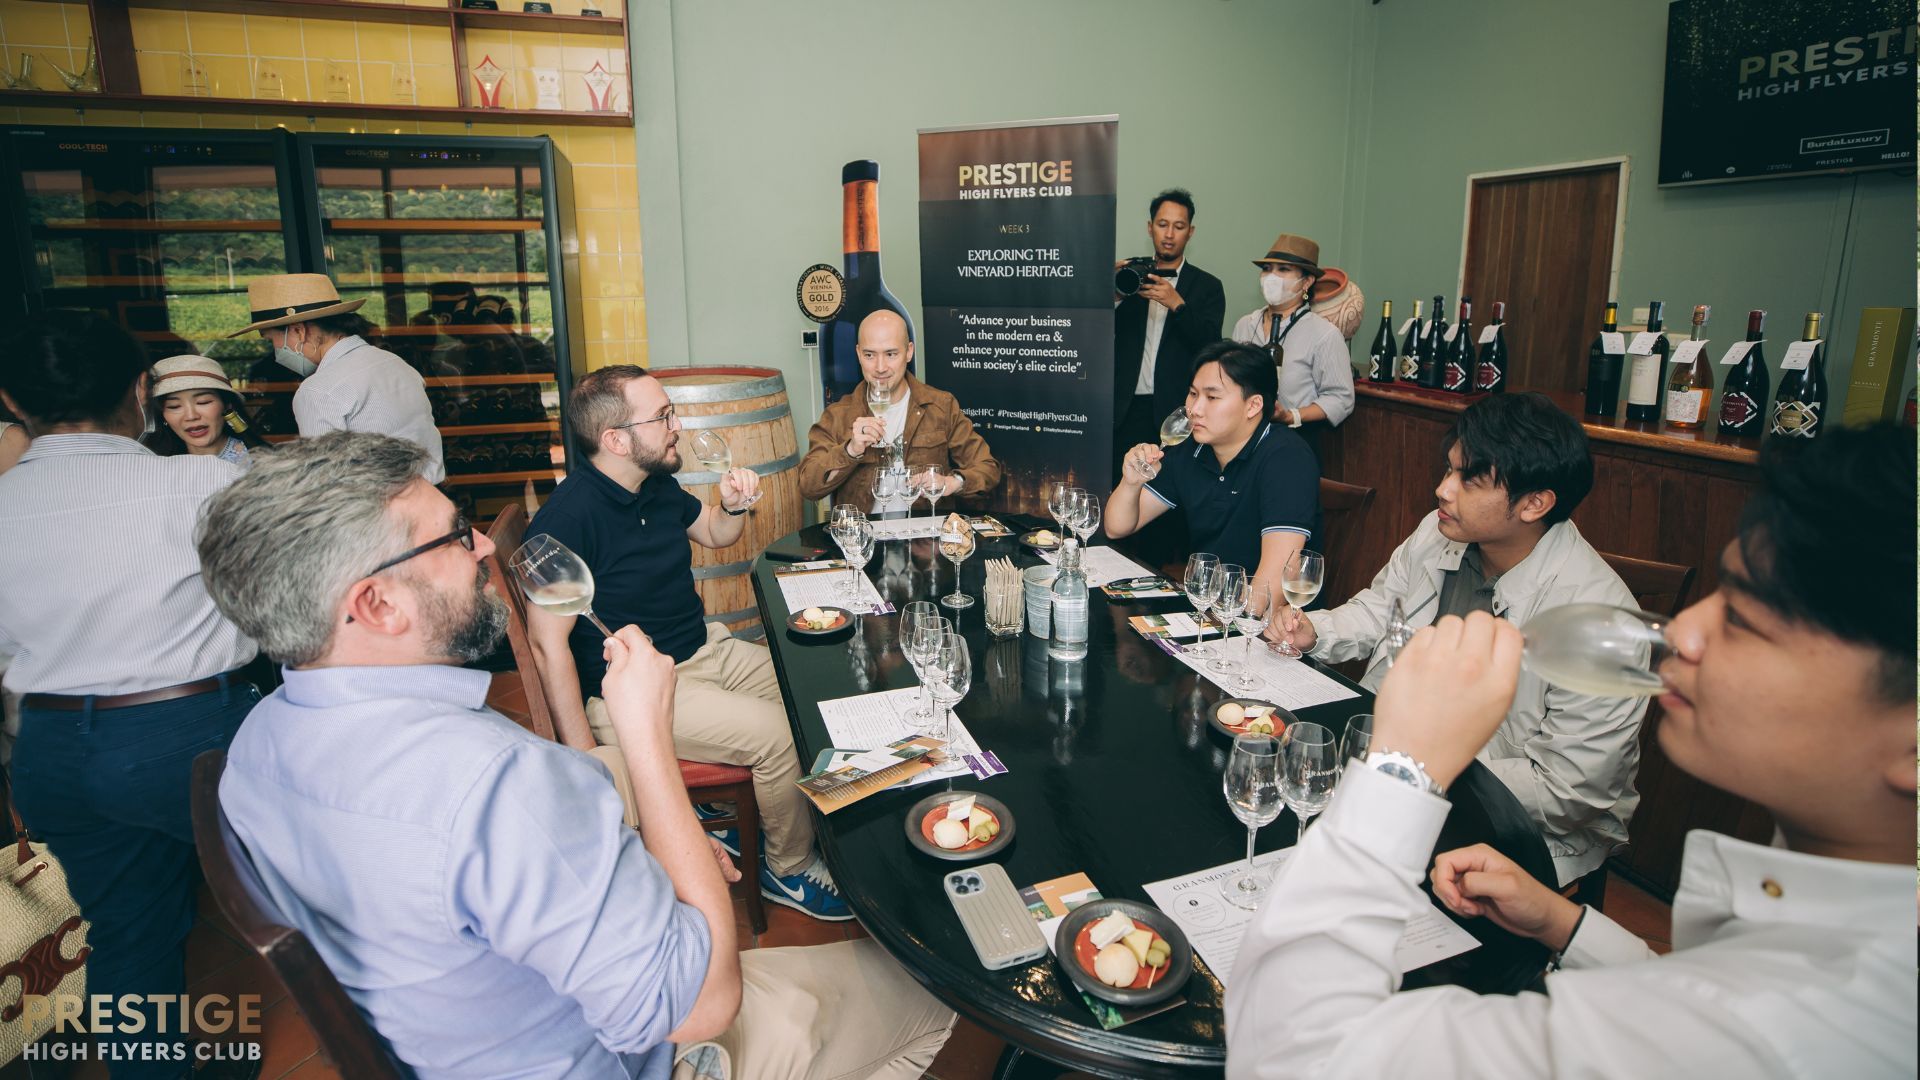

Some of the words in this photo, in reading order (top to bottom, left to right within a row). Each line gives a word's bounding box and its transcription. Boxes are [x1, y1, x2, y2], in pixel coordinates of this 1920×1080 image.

[1737, 79, 1800, 101] HIGH
[1809, 61, 1909, 89] FLYERS
[1807, 135, 1882, 149] BurdaLuxury
[1816, 157, 1854, 165] PRESTIGE
[959, 160, 1073, 186] PRESTIGE
[960, 189, 990, 200] HIGH
[993, 187, 1036, 199] FLYERS
[1039, 185, 1073, 197] CLUB
[999, 224, 1024, 234] WEEK
[1025, 224, 1030, 233] 3
[967, 249, 1034, 261] EXPLORING
[1035, 248, 1060, 260] THE
[957, 265, 1014, 277] VINEYARD
[1016, 265, 1074, 277] HERITAGE
[810, 275, 832, 284] AWC
[809, 294, 834, 302] GOLD
[1005, 317, 1028, 328] your
[1030, 315, 1072, 327] business
[966, 329, 976, 340] in
[977, 329, 994, 340] the
[995, 330, 1033, 341] modern
[1035, 333, 1051, 342] era
[1053, 331, 1064, 342] &
[952, 343, 992, 355] enhance
[993, 347, 1017, 358] your
[1018, 346, 1078, 358] connections
[951, 358, 981, 369] within
[1025, 360, 1047, 372] elite
[997, 409, 1088, 423] #PrestigeHighFlyersClub
